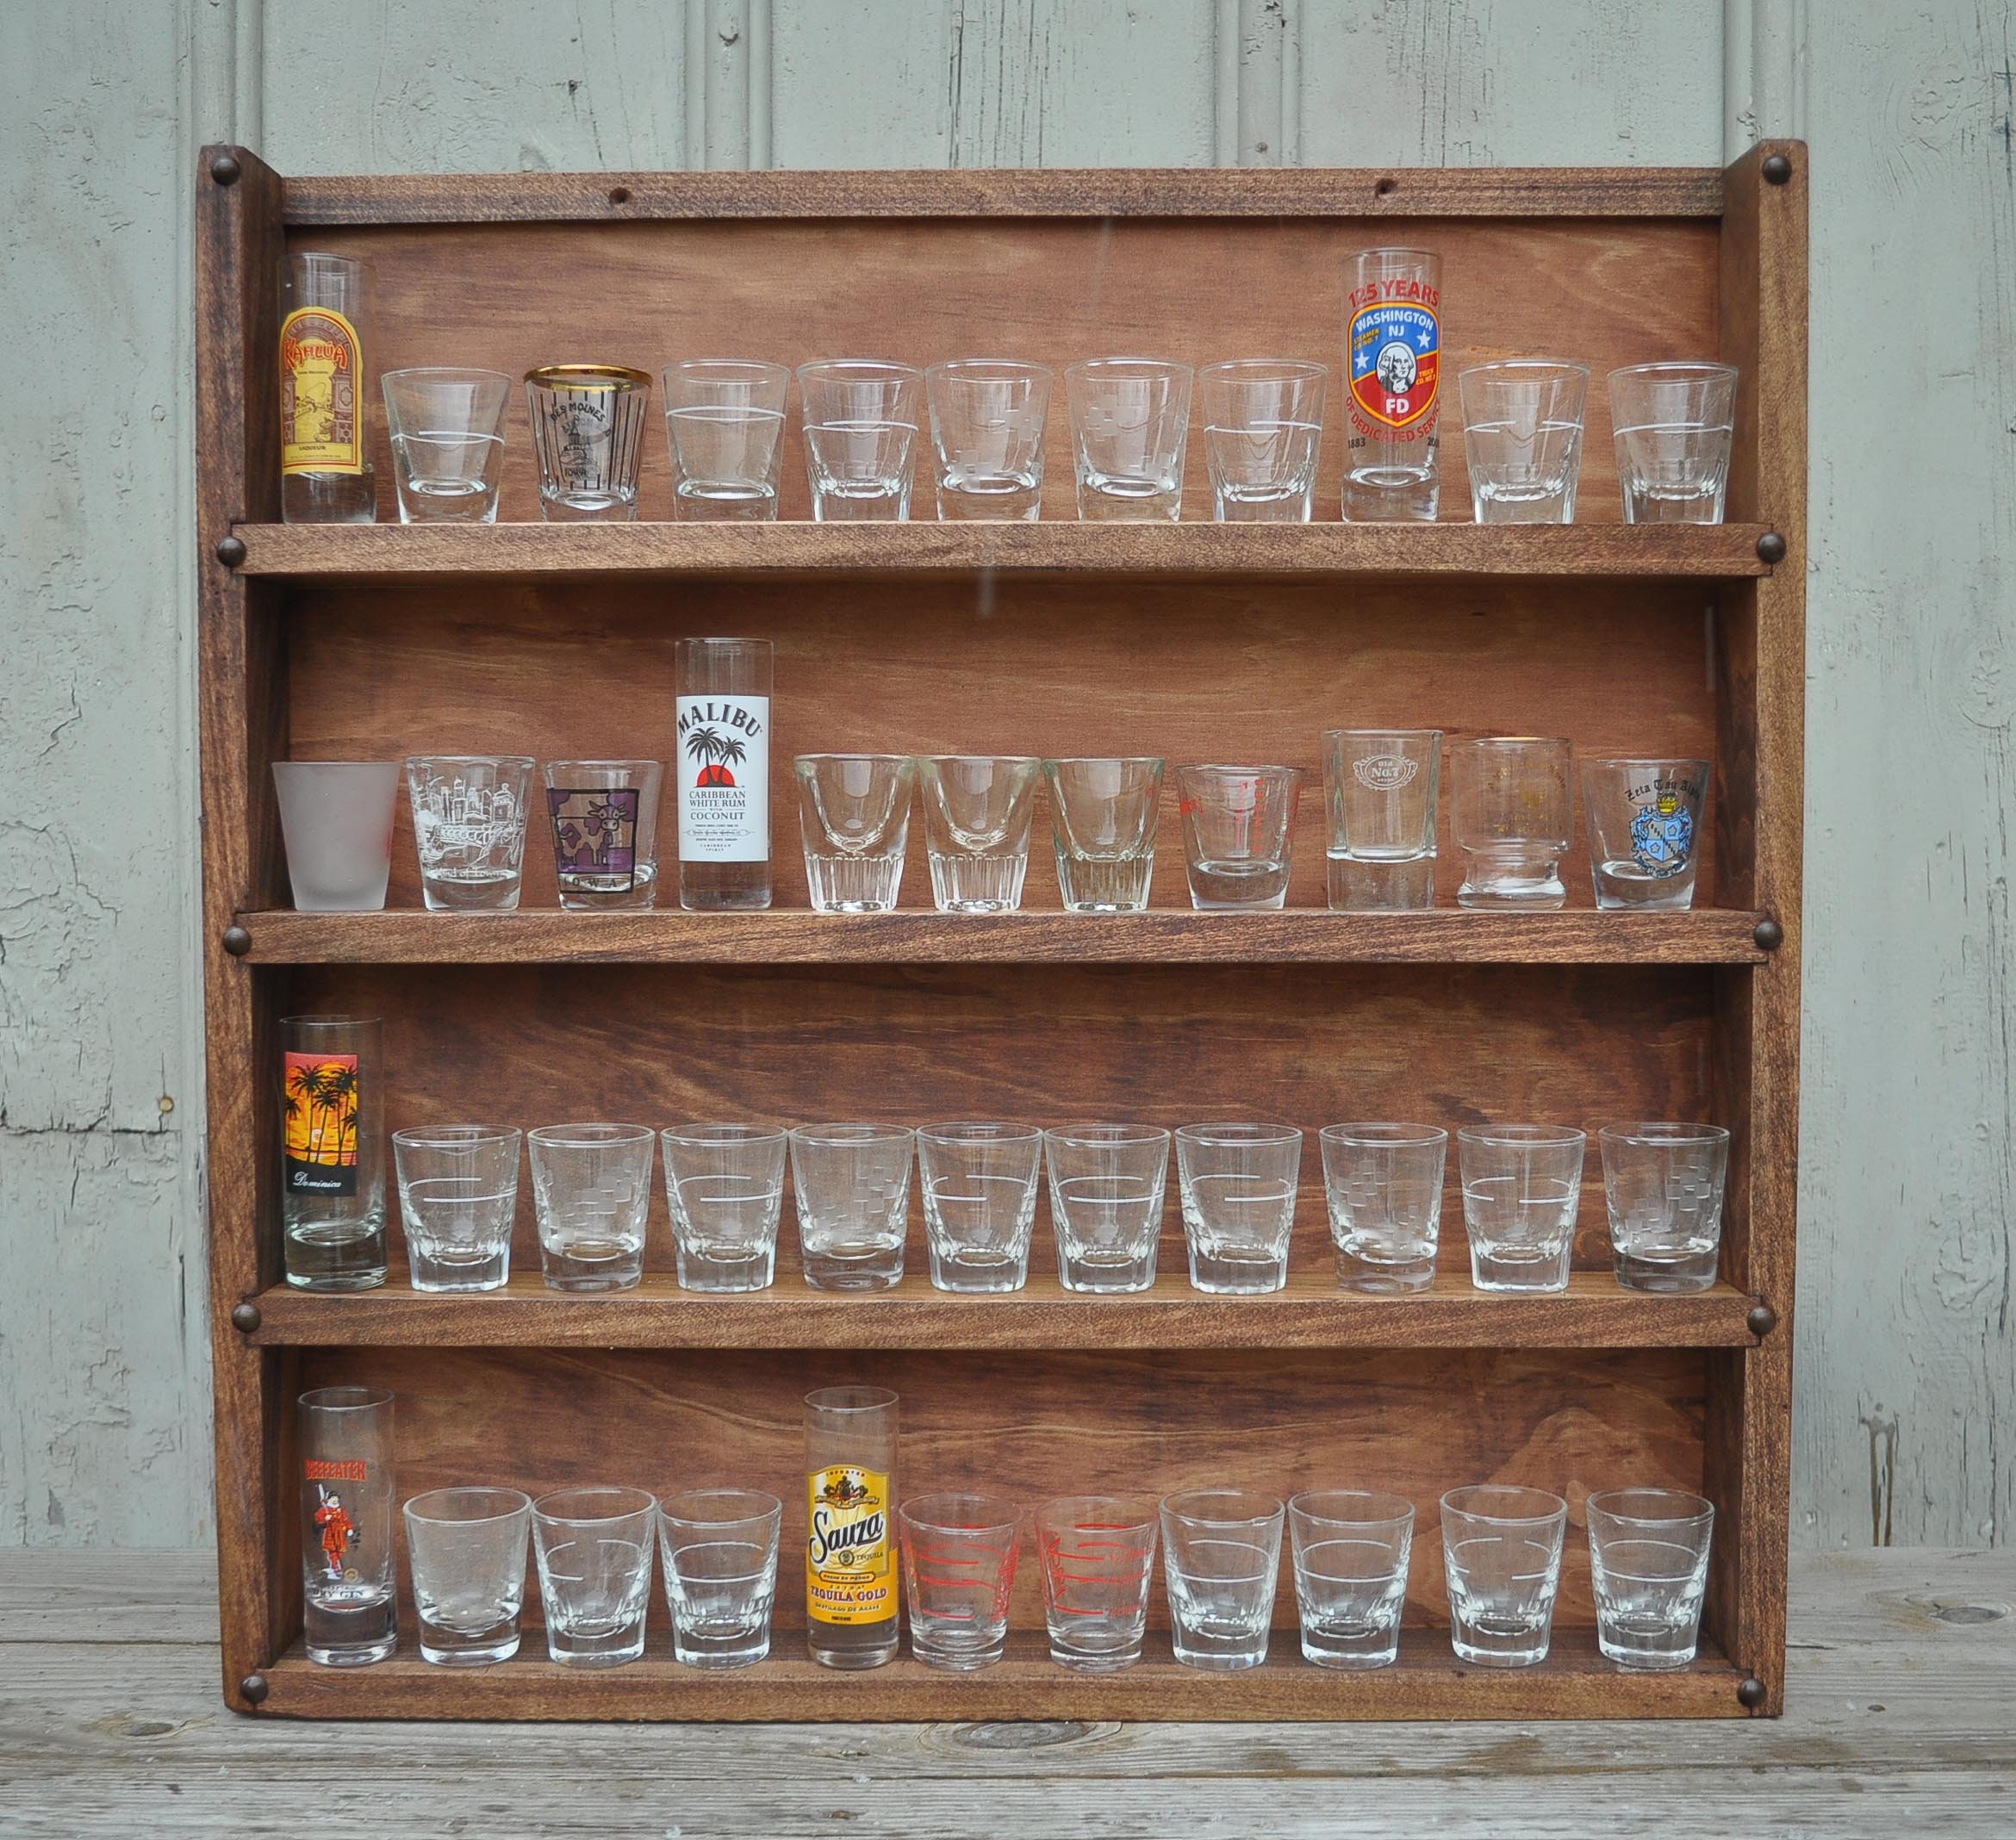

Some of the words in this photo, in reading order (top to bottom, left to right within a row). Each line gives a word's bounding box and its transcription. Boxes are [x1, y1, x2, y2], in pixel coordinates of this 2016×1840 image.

[1348, 283, 1378, 308] 125
[1381, 279, 1440, 307] YEARS
[1355, 310, 1434, 333] WASHINGTON
[1388, 325, 1405, 337] NJ
[283, 337, 347, 370] KAHLÚA
[551, 405, 567, 421] DES
[569, 402, 606, 422] MOINES
[1385, 398, 1409, 414] FD
[1346, 396, 1356, 413] OF
[1351, 413, 1416, 443] DEDICATED
[1416, 394, 1440, 438] SERVIC
[1347, 438, 1366, 449] 1883
[678, 702, 762, 739] MALIBU
[689, 791, 746, 799] CARIBBEAN
[1625, 785, 1651, 802] Zeta
[690, 811, 745, 820] COCONUT
[293, 1172, 342, 1188] Dominica
[305, 1459, 366, 1481] BEEFEATER
[809, 1511, 883, 1563] Sauza
[856, 1551, 883, 1561] TEQUILA
[811, 1586, 854, 1602] TEQUILA
[856, 1588, 887, 1601] GOLD
